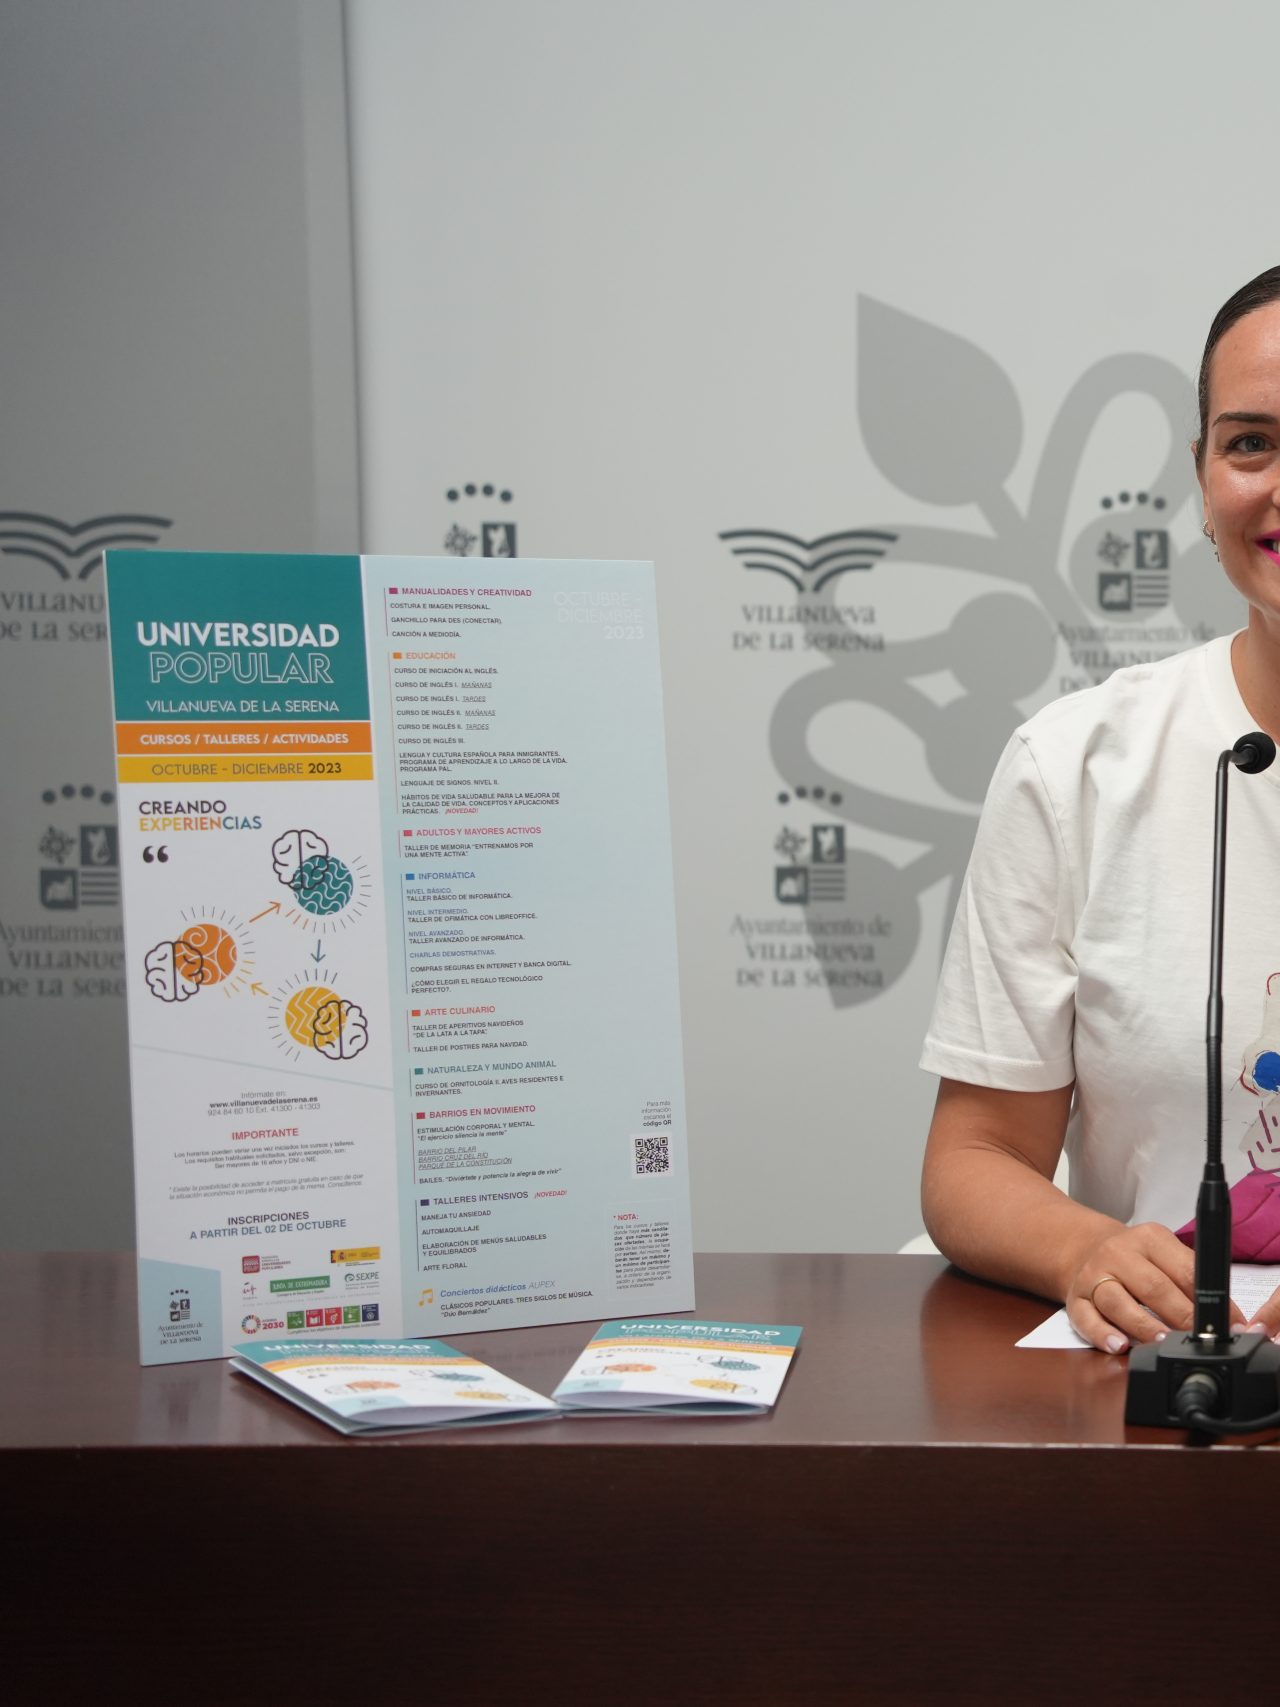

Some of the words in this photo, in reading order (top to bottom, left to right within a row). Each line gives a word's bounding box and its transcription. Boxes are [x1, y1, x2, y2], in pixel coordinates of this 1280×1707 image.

[401, 588, 468, 596] MANUALIDADES
[470, 588, 475, 596] Y
[477, 588, 532, 596] CREATIVIDAD
[137, 622, 340, 647] UNIVERSIDAD
[406, 651, 456, 660] EDUCACIÓN
[149, 652, 334, 683] POPULAR
[146, 700, 236, 713] VILLANUEVA
[240, 701, 258, 713] DE
[262, 701, 280, 713] LA
[285, 701, 340, 712] SERENA
[140, 734, 191, 745] CURSOS
[203, 734, 260, 744] TALLERES
[272, 734, 349, 744] ACTIVIDADES
[151, 763, 217, 775] OCTUBRE
[232, 763, 303, 775] DICIEMBRE
[308, 763, 342, 774] 2023
[139, 800, 227, 815] CREANDO
[139, 816, 262, 832] EXPERIENCIAS
[416, 829, 455, 837] ADULTOS
[457, 828, 462, 836] Y
[464, 828, 504, 836] MAYORES
[506, 827, 542, 835] ACTIVOS
[418, 871, 476, 881] INFORMÁTICA
[425, 1008, 447, 1016] ARTE
[449, 1006, 495, 1015] CULINARIO
[427, 1064, 483, 1075] NATURALEZA
[484, 1064, 490, 1072] Y
[492, 1062, 524, 1072] MUNDO
[525, 1060, 557, 1070] ANIMAL
[210, 1095, 318, 1109] www.villanuevadelaserena.es
[429, 1110, 468, 1119] BARRIOS
[470, 1108, 481, 1117] EN
[484, 1105, 536, 1116] MOVIMIENTO
[232, 1128, 299, 1141] IMPORTANTE
[433, 1195, 477, 1205] TALLERES
[479, 1192, 529, 1202] INTENSIVOS
[227, 1211, 309, 1226] INSCRIPCIONES
[421, 1213, 448, 1221] MANEJA
[458, 1210, 491, 1218] ANSIEDAD
[190, 1231, 198, 1239] A
[200, 1227, 238, 1239] PARTIR
[241, 1226, 262, 1236] DEL
[264, 1225, 278, 1234] 02
[280, 1223, 293, 1233] DE
[296, 1219, 347, 1232] OCTUBRE
[422, 1225, 480, 1236] AUTOMAQUILLAJE
[441, 1262, 467, 1270] FLORAL
[356, 1272, 379, 1281] SEXPE
[440, 1287, 484, 1298] Conciertos
[485, 1284, 527, 1294] didácticos
[441, 1301, 473, 1311] CLÁSICOS
[516, 1296, 533, 1304] TRES
[534, 1294, 557, 1303] SIGLOS
[262, 1322, 284, 1330] 2030
[620, 1324, 781, 1337] UNIVERSIDAD
[263, 1343, 432, 1352] UNIVERSIDAD
